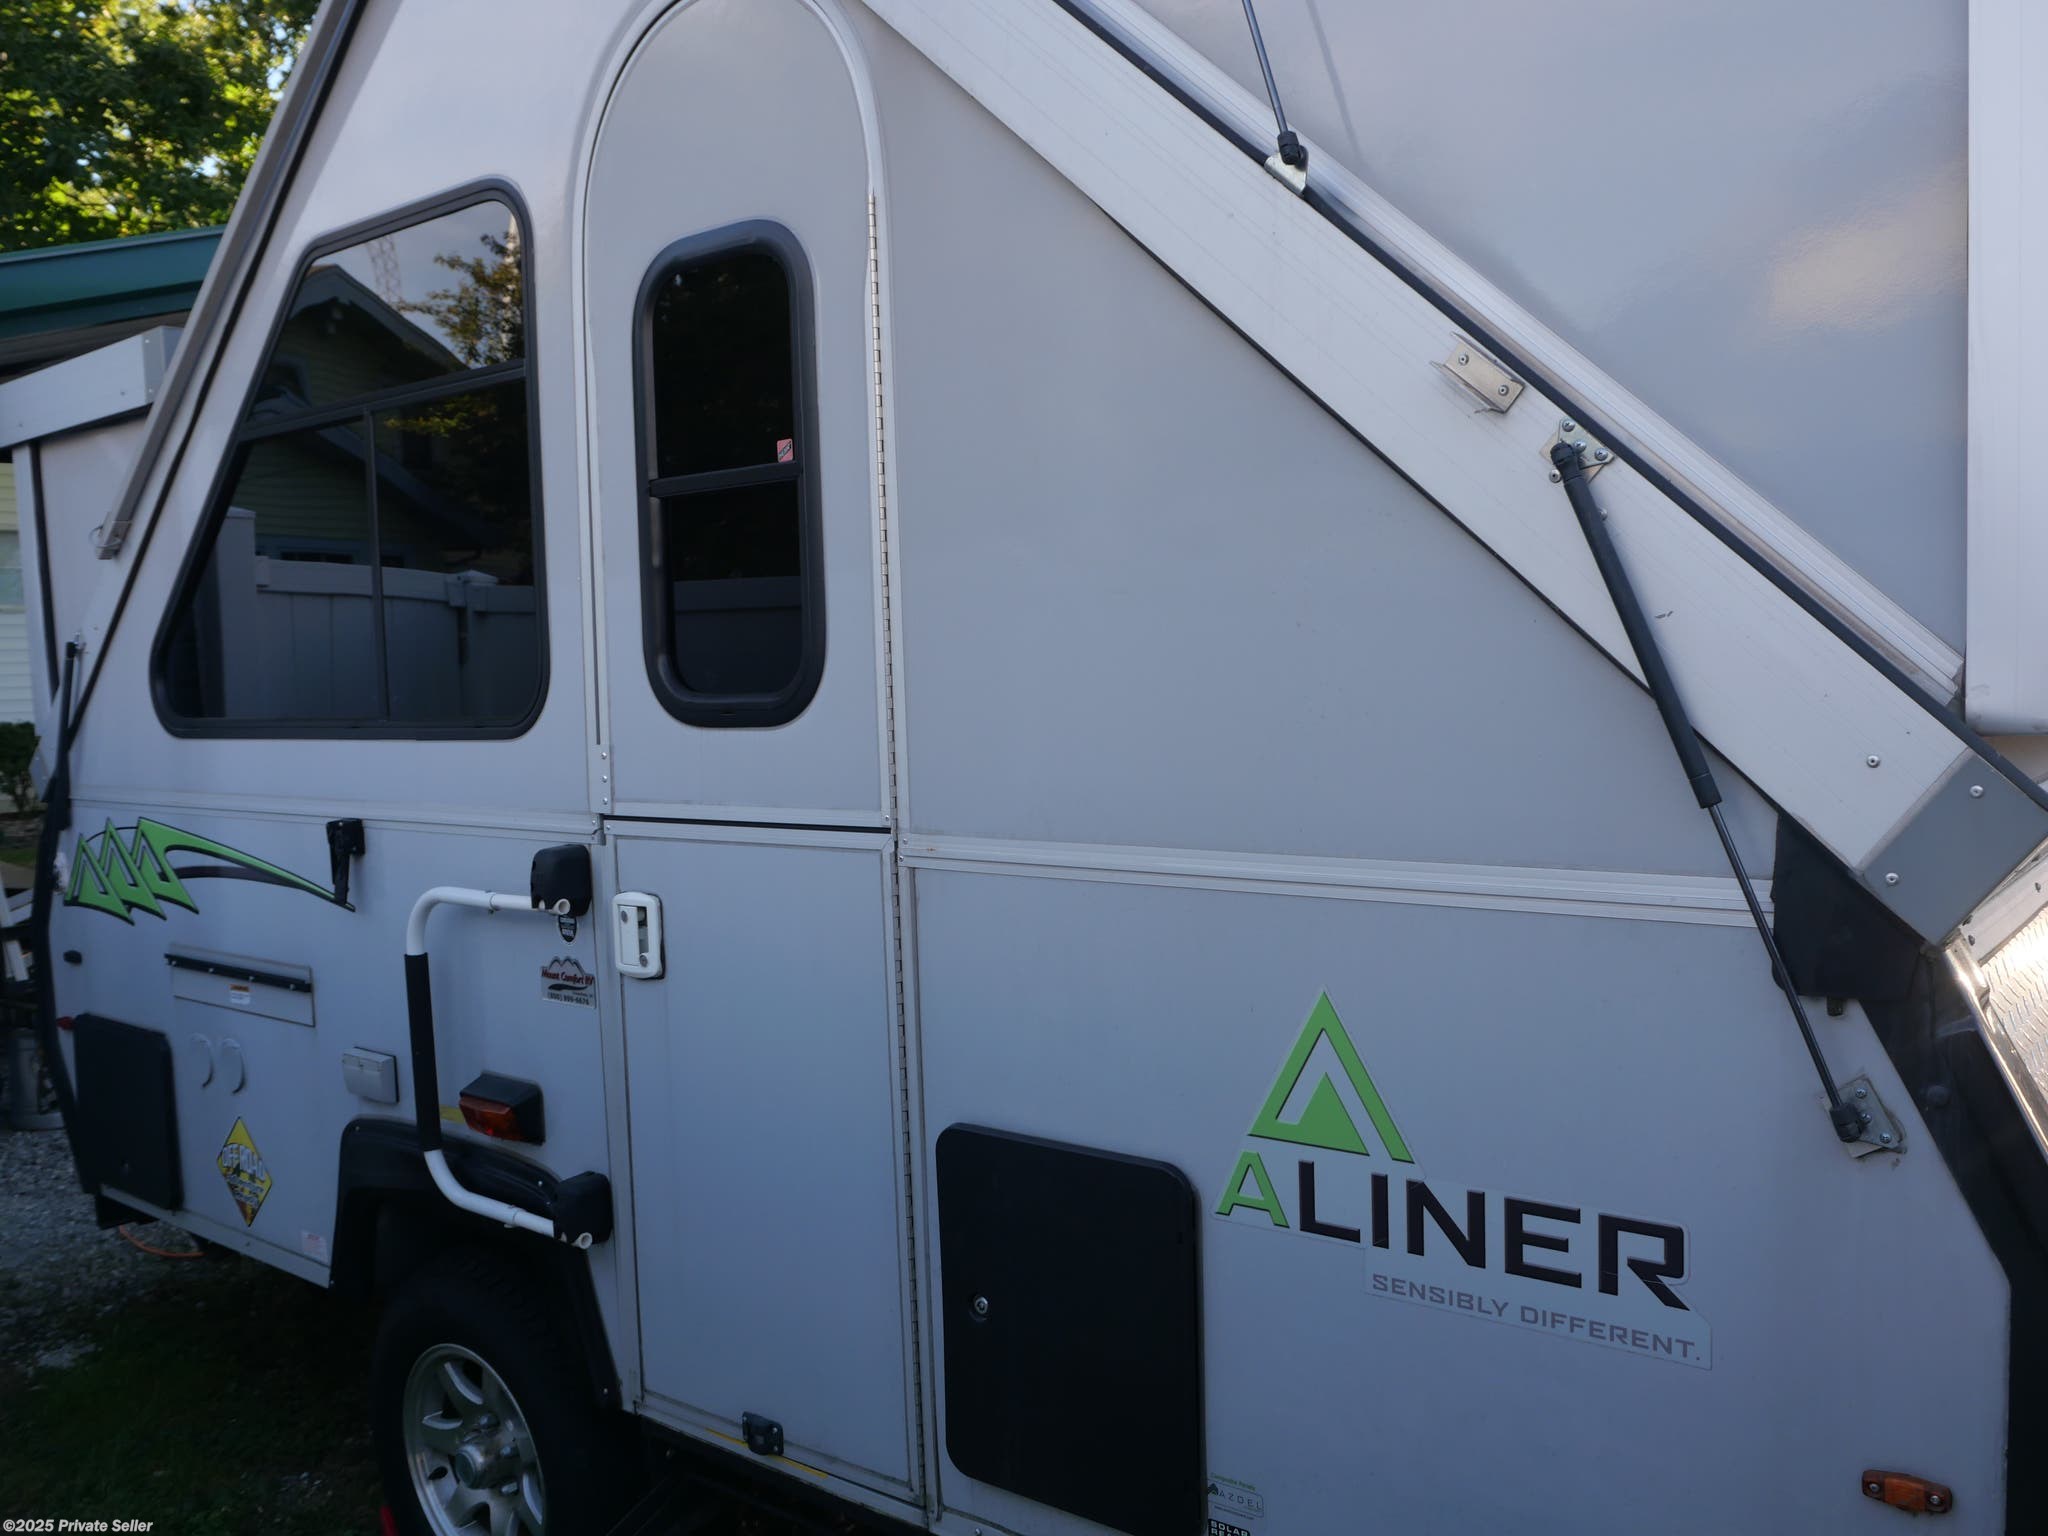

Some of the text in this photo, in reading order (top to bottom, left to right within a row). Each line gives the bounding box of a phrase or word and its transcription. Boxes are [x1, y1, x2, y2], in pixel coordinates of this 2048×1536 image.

[1215, 1150, 1691, 1311] ALINER
[1372, 1273, 1702, 1361] SENSIBLY DIFFERENT.
[1219, 1490, 1263, 1509] AZDEL
[1210, 1520, 1249, 1536] SOLAR
